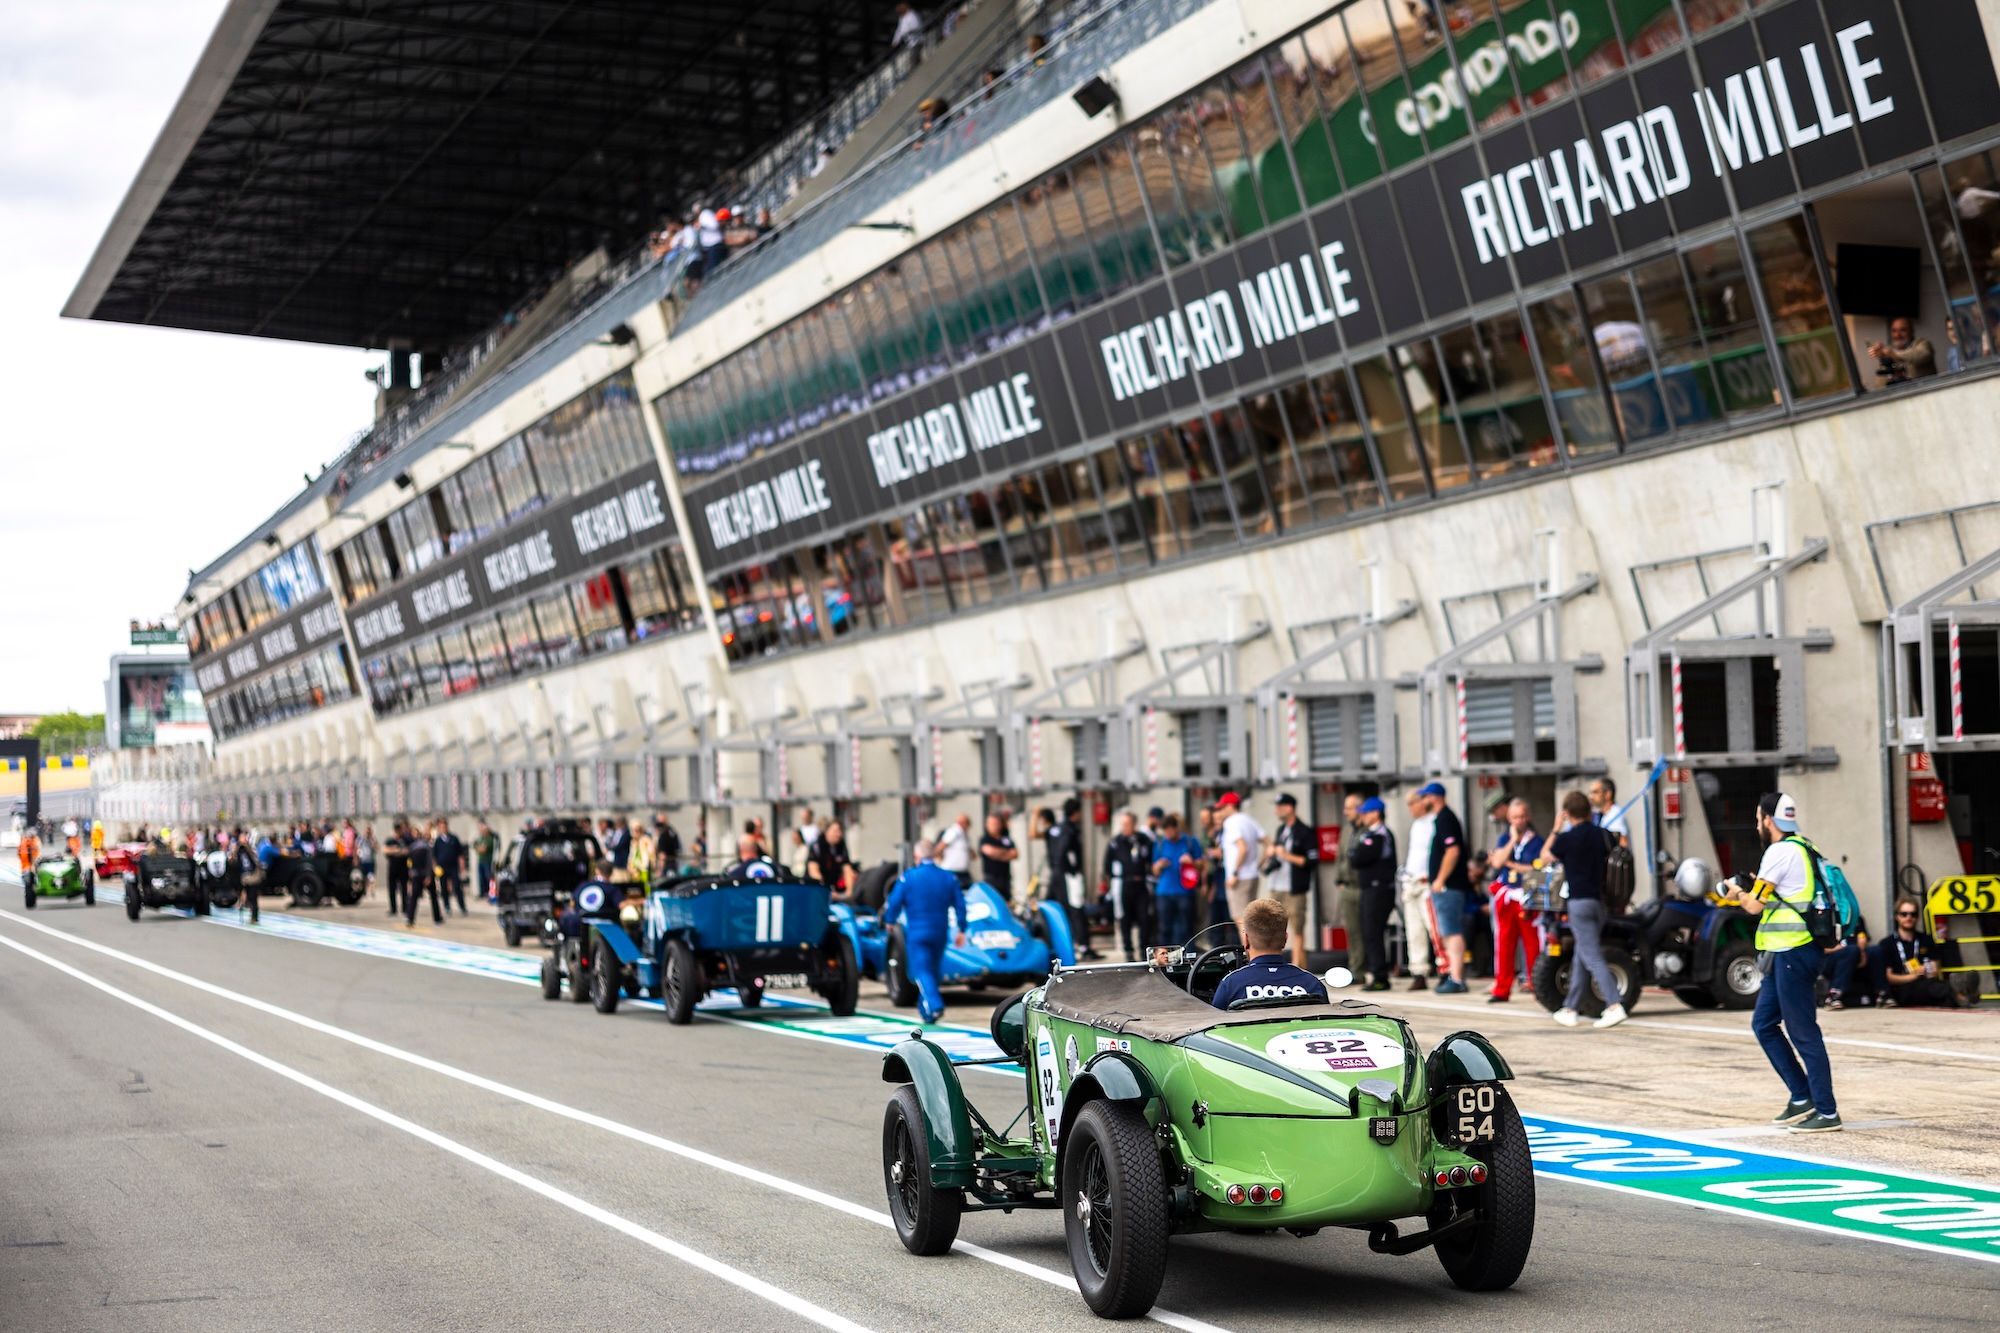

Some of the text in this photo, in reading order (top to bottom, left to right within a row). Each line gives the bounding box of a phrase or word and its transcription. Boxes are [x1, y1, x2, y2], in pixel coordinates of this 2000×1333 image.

[1460, 20, 1894, 264] RICHARD MILLE
[1100, 241, 1360, 401] RICHARD MILLE
[867, 372, 1042, 488] RICHARD MILLE
[705, 459, 831, 549] RICHARD MILLE
[1948, 879, 1996, 913] 85
[755, 895, 784, 942] 11
[1245, 984, 1308, 1000] pace
[1305, 1039, 1368, 1055] 82
[1330, 1058, 1372, 1066] QATAR
[1043, 1068, 1055, 1107] 82
[1458, 1086, 1495, 1114] GO
[1458, 1114, 1495, 1143] 54
